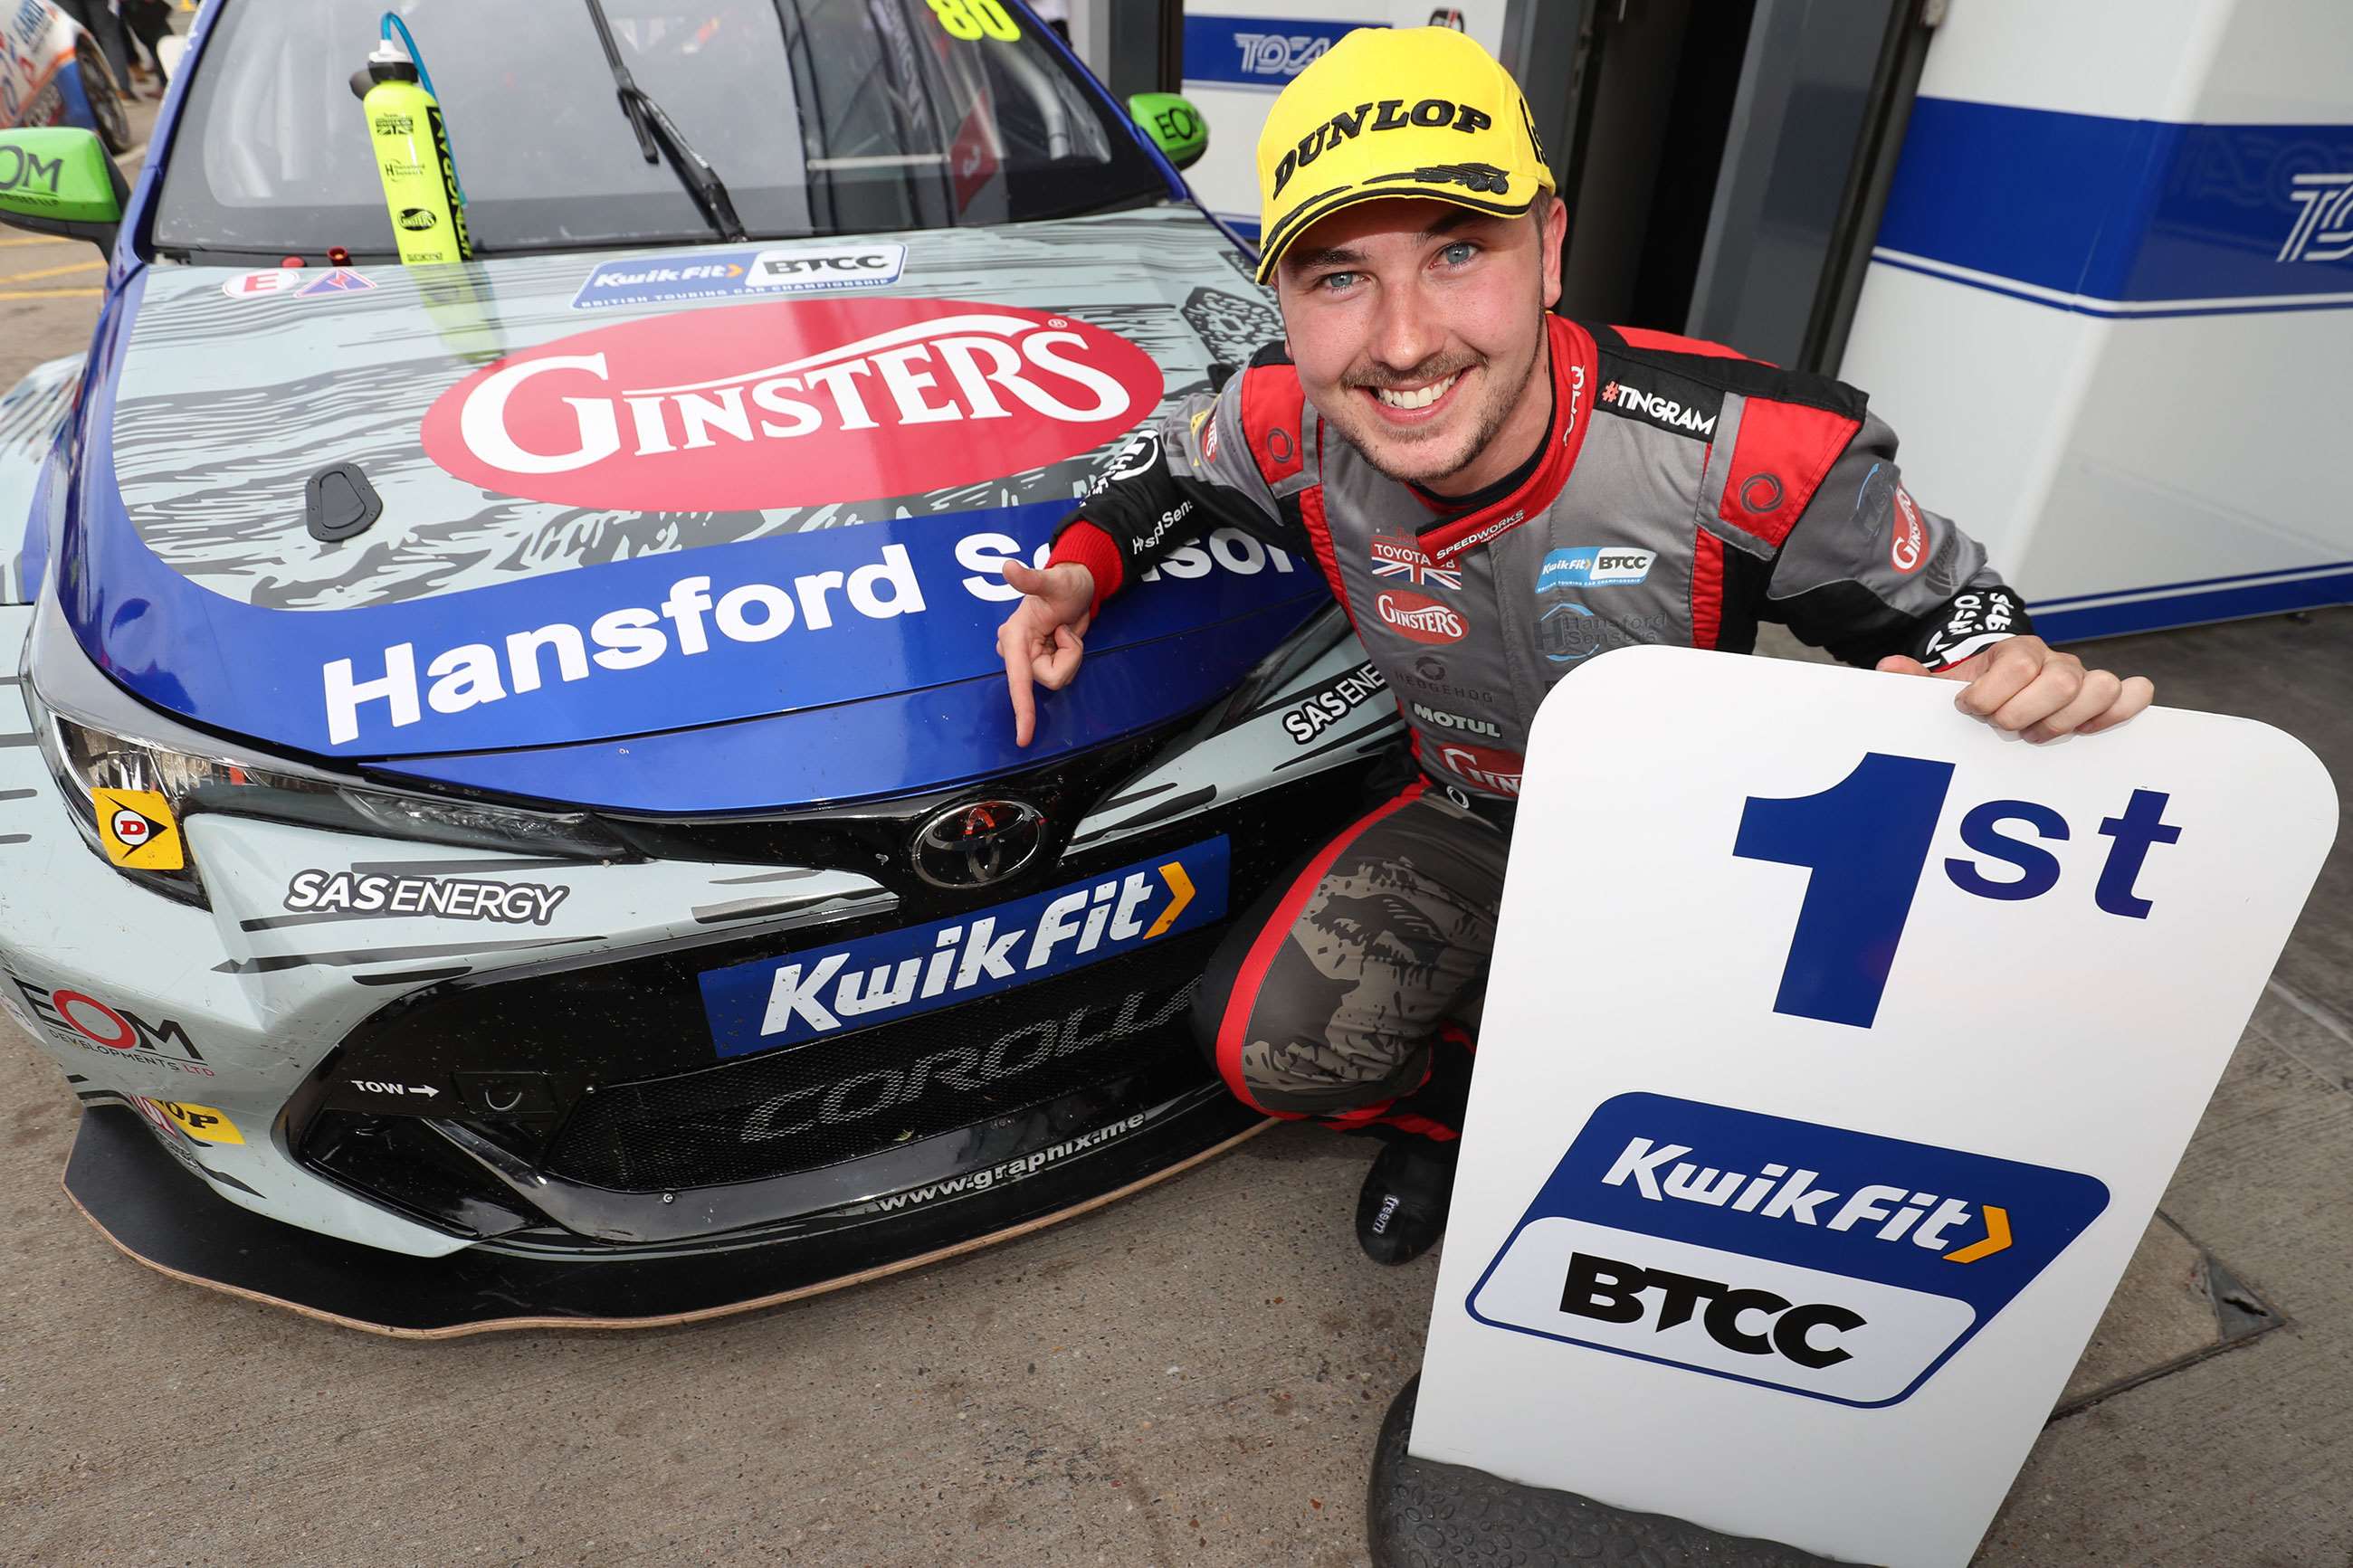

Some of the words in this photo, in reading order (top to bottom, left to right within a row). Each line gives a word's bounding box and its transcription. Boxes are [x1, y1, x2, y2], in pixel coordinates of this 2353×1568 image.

[926, 0, 1021, 42] 80
[0, 145, 63, 193] OM
[1273, 99, 1491, 201] DUNLOP
[243, 272, 280, 293] E
[763, 255, 890, 275] BTCC
[580, 296, 648, 309] BRITISH
[654, 289, 728, 302] TOURING
[733, 285, 766, 296] CAR
[770, 277, 890, 293] CHAMPIONSHIP
[461, 328, 1130, 474] GINSTERS
[1601, 380, 1717, 435] #TINGRAM
[1374, 543, 1432, 566] TOYOTA
[1436, 509, 1525, 560] SPEEDWORKS
[1598, 556, 1648, 570] BTCC
[1377, 594, 1463, 638] GINSTERS
[1563, 612, 1668, 631] Hansford
[322, 543, 927, 746] Hansford
[1564, 631, 1659, 645] Sensors
[1395, 669, 1494, 703] HEDGEHOG
[1414, 702, 1501, 738] MOTUL
[119, 820, 147, 838] D
[1732, 751, 2183, 1030] 1st
[12, 976, 205, 1061] EOM
[49, 1029, 181, 1071] DEVELOPMENTS
[182, 1063, 215, 1078] LTD
[350, 1079, 405, 1096] TOW
[1558, 1250, 1869, 1370] BTCC
